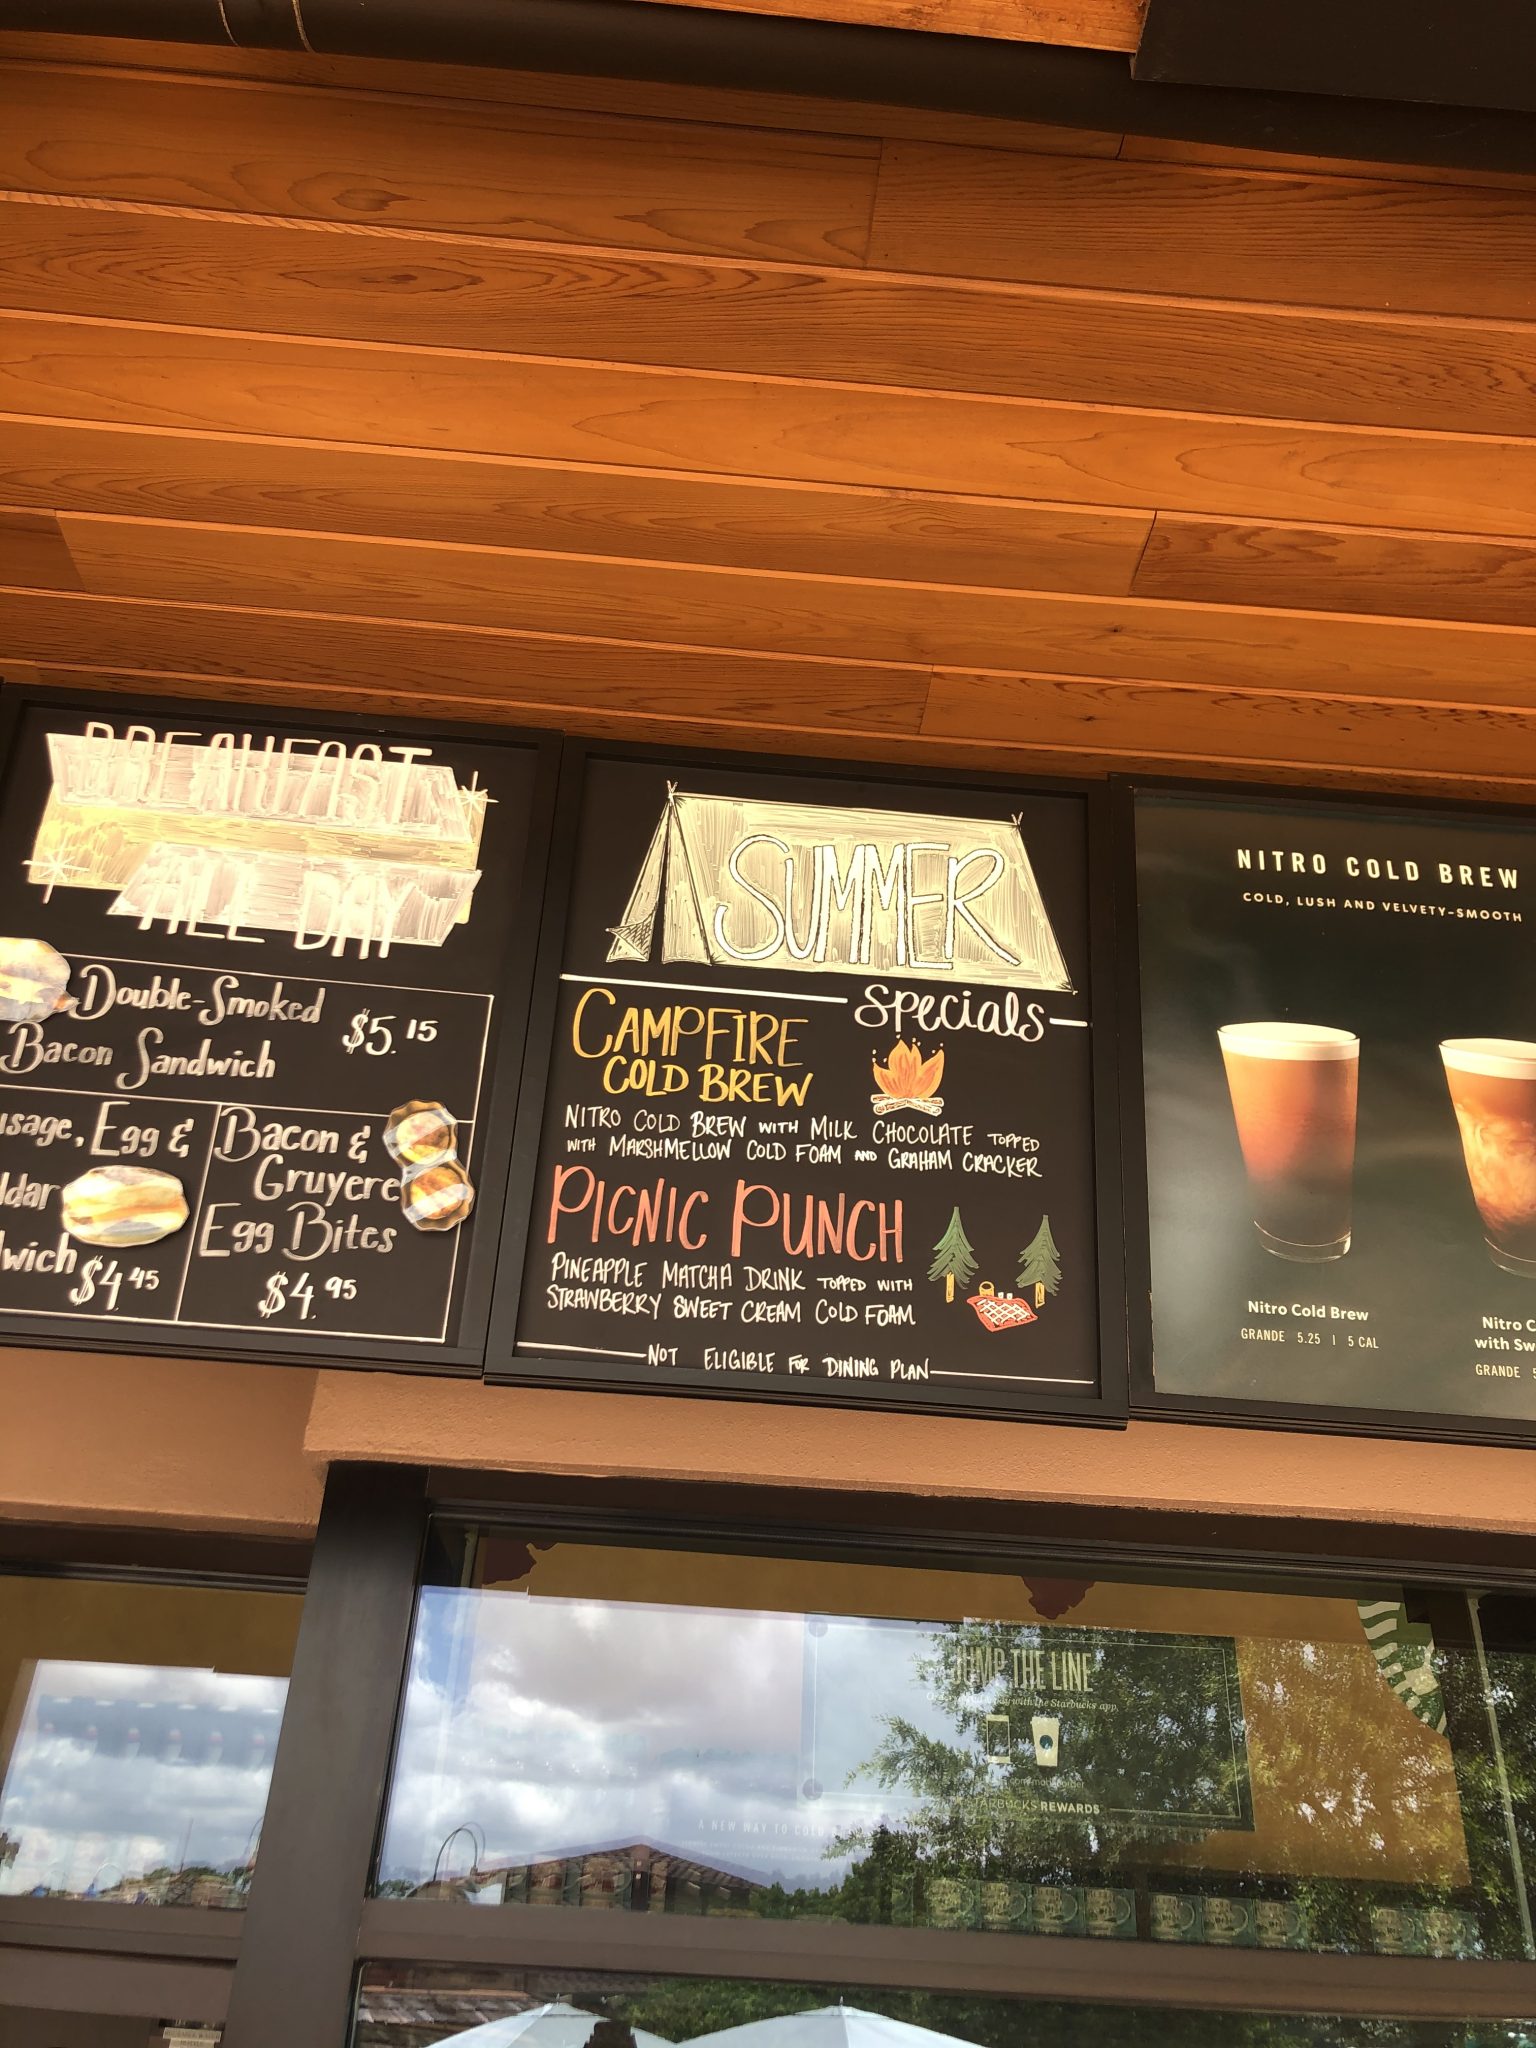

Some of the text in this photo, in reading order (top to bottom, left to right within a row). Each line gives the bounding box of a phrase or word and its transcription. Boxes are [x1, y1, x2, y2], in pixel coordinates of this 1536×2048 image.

[1236, 848, 1520, 891] NITRO COLD BREW
[713, 833, 1021, 970] SUMMER
[1242, 891, 1523, 924] COLD, LUSH AND VELVETY-SMOOTH
[71, 964, 326, 1025] Double-Smoked
[571, 987, 809, 1068] CAMPFIRE
[0, 1020, 277, 1090] Bacon Sandwich
[602, 1058, 813, 1108] COLD BREW
[89, 1101, 160, 1157] Egg
[167, 1117, 194, 1158] &
[213, 1106, 372, 1164] Bacon &
[564, 1104, 1042, 1153] NITRO COLD BREW WITH MILK CHOCOLATE TOPPED
[566, 1134, 1043, 1179] WITH MARSHMELLOW COLD FOAM AND GRAHAM CRACKER
[253, 1154, 401, 1206] Gruyere
[199, 1201, 398, 1262] Egg Bites
[546, 1163, 904, 1264] PICNIC PUNCH
[551, 1250, 914, 1293] PINEAPPLE MATCHA DRINK TOPPED WITH
[546, 1281, 917, 1328] STRAWBERRY SWEET CREAM COLD FOAM
[1247, 1300, 1370, 1322] Nitro Cold Brew
[1482, 1316, 1523, 1332] Nitro
[1240, 1327, 1286, 1343] GRANDE
[1296, 1331, 1322, 1345] 5.25
[1347, 1335, 1356, 1348] 5
[1358, 1336, 1380, 1350] CAL
[1474, 1336, 1510, 1351] with
[647, 1344, 679, 1368] NOT
[703, 1346, 776, 1373] ELIGIBLE
[822, 1355, 880, 1379] DINING
[889, 1358, 931, 1382] PLAN
[1475, 1363, 1521, 1379] GRANDE
[1010, 1648, 1046, 1691] THE
[1051, 1650, 1094, 1692] LINE
[1050, 1699, 1096, 1710] Starbucks
[1040, 1801, 1100, 1815] REWARDS
